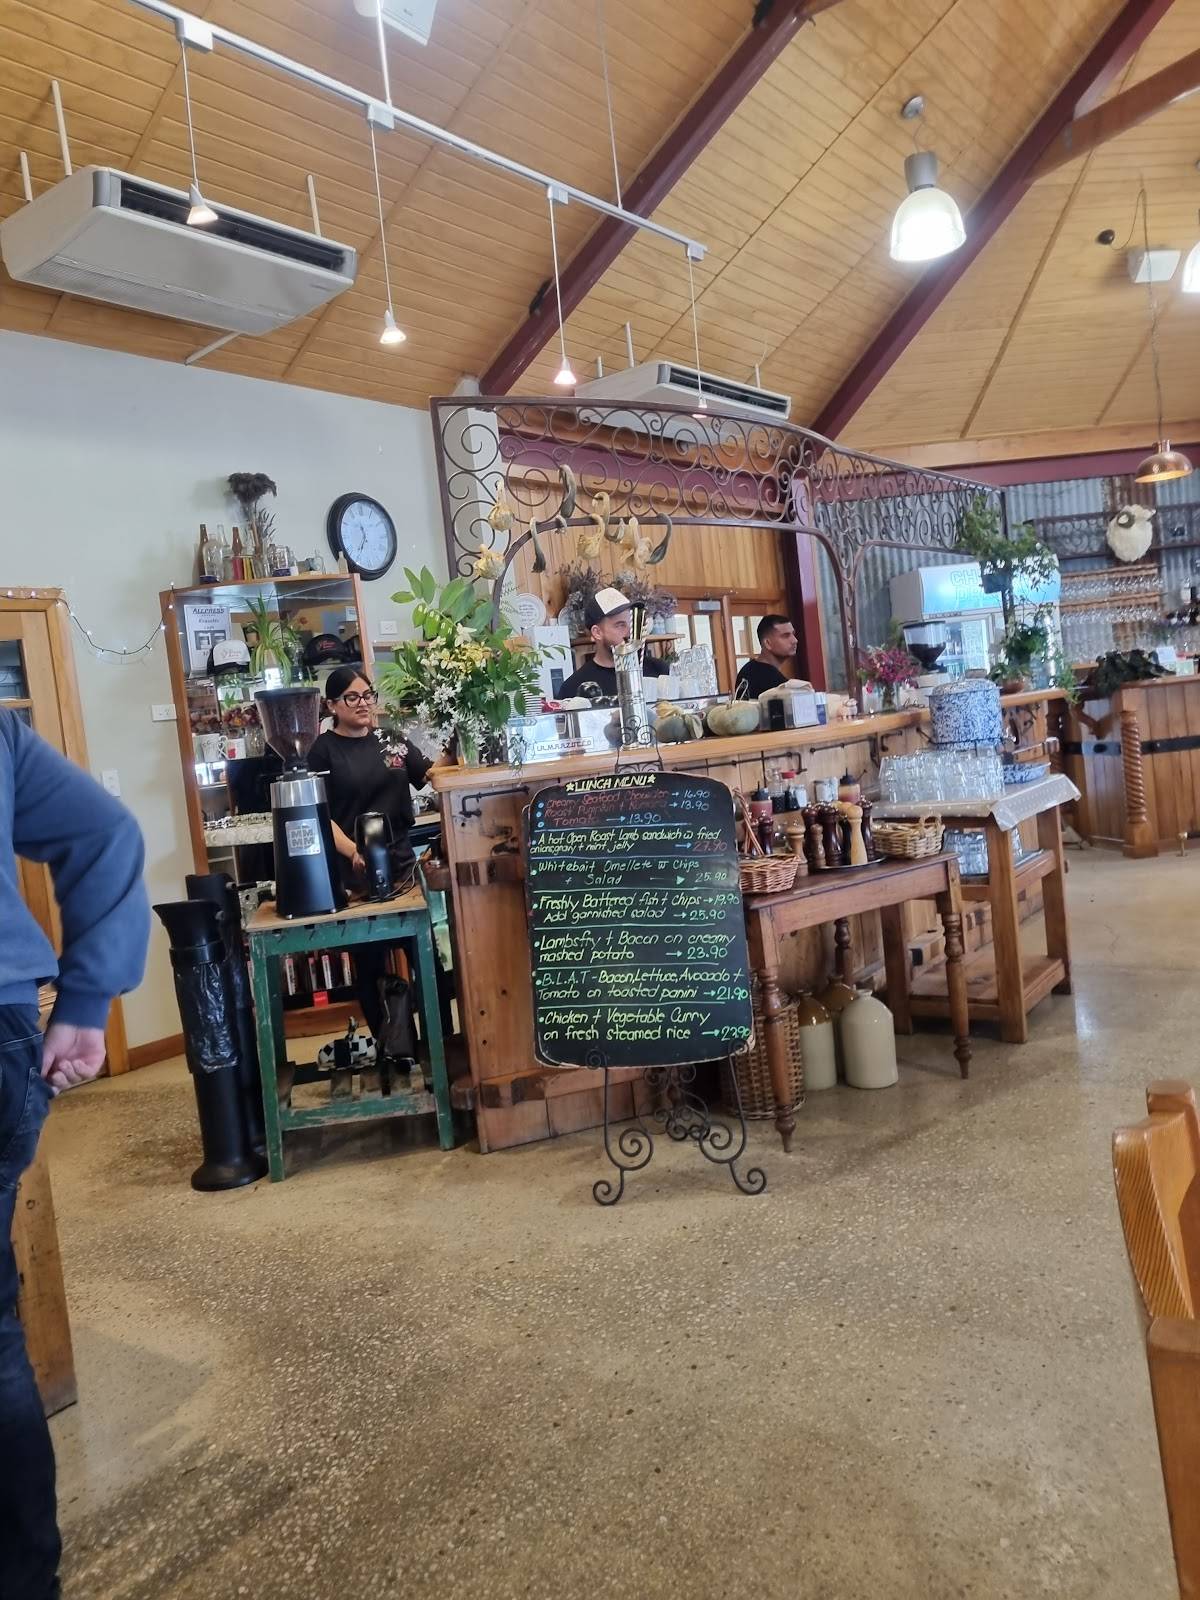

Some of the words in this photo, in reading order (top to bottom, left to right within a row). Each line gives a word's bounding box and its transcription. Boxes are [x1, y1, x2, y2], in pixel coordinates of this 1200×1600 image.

[575, 777, 612, 792] LUNCH
[614, 775, 648, 788] MENU
[684, 789, 711, 799] 16.90
[681, 800, 710, 811] 13.90
[537, 833, 545, 845] A
[548, 832, 565, 844] hot
[566, 832, 587, 846] Open
[589, 829, 615, 842] Roast
[642, 827, 683, 841] sandwich
[696, 826, 722, 840] fried
[585, 842, 607, 852] mint
[607, 840, 635, 854] jelly
[538, 860, 596, 873] Whitebait
[584, 873, 623, 886] Salad
[539, 894, 580, 913] Freshly
[582, 891, 637, 908] Battered
[639, 891, 659, 906] fish
[713, 893, 740, 907] 19.90
[543, 911, 568, 923] Add
[571, 906, 628, 925] garnished
[630, 906, 667, 919] salad
[689, 909, 726, 921] 25.90
[618, 930, 659, 945] Bacon
[664, 934, 683, 944] on
[687, 933, 737, 947] creamy
[539, 948, 585, 963] mashed
[589, 945, 635, 964] potato
[687, 945, 728, 960] 23.90
[538, 984, 580, 1001] Tomato
[587, 988, 602, 998] on
[607, 982, 661, 998] toasted
[659, 984, 699, 1002] panini
[716, 985, 749, 1001] 21.90
[544, 1009, 589, 1024] Chicken
[607, 1007, 666, 1028] Vegetable
[670, 1006, 711, 1026] Curry
[543, 1030, 559, 1041] on
[565, 1024, 599, 1041] fresh
[606, 1023, 662, 1042] steamed
[666, 1025, 691, 1040] rice
